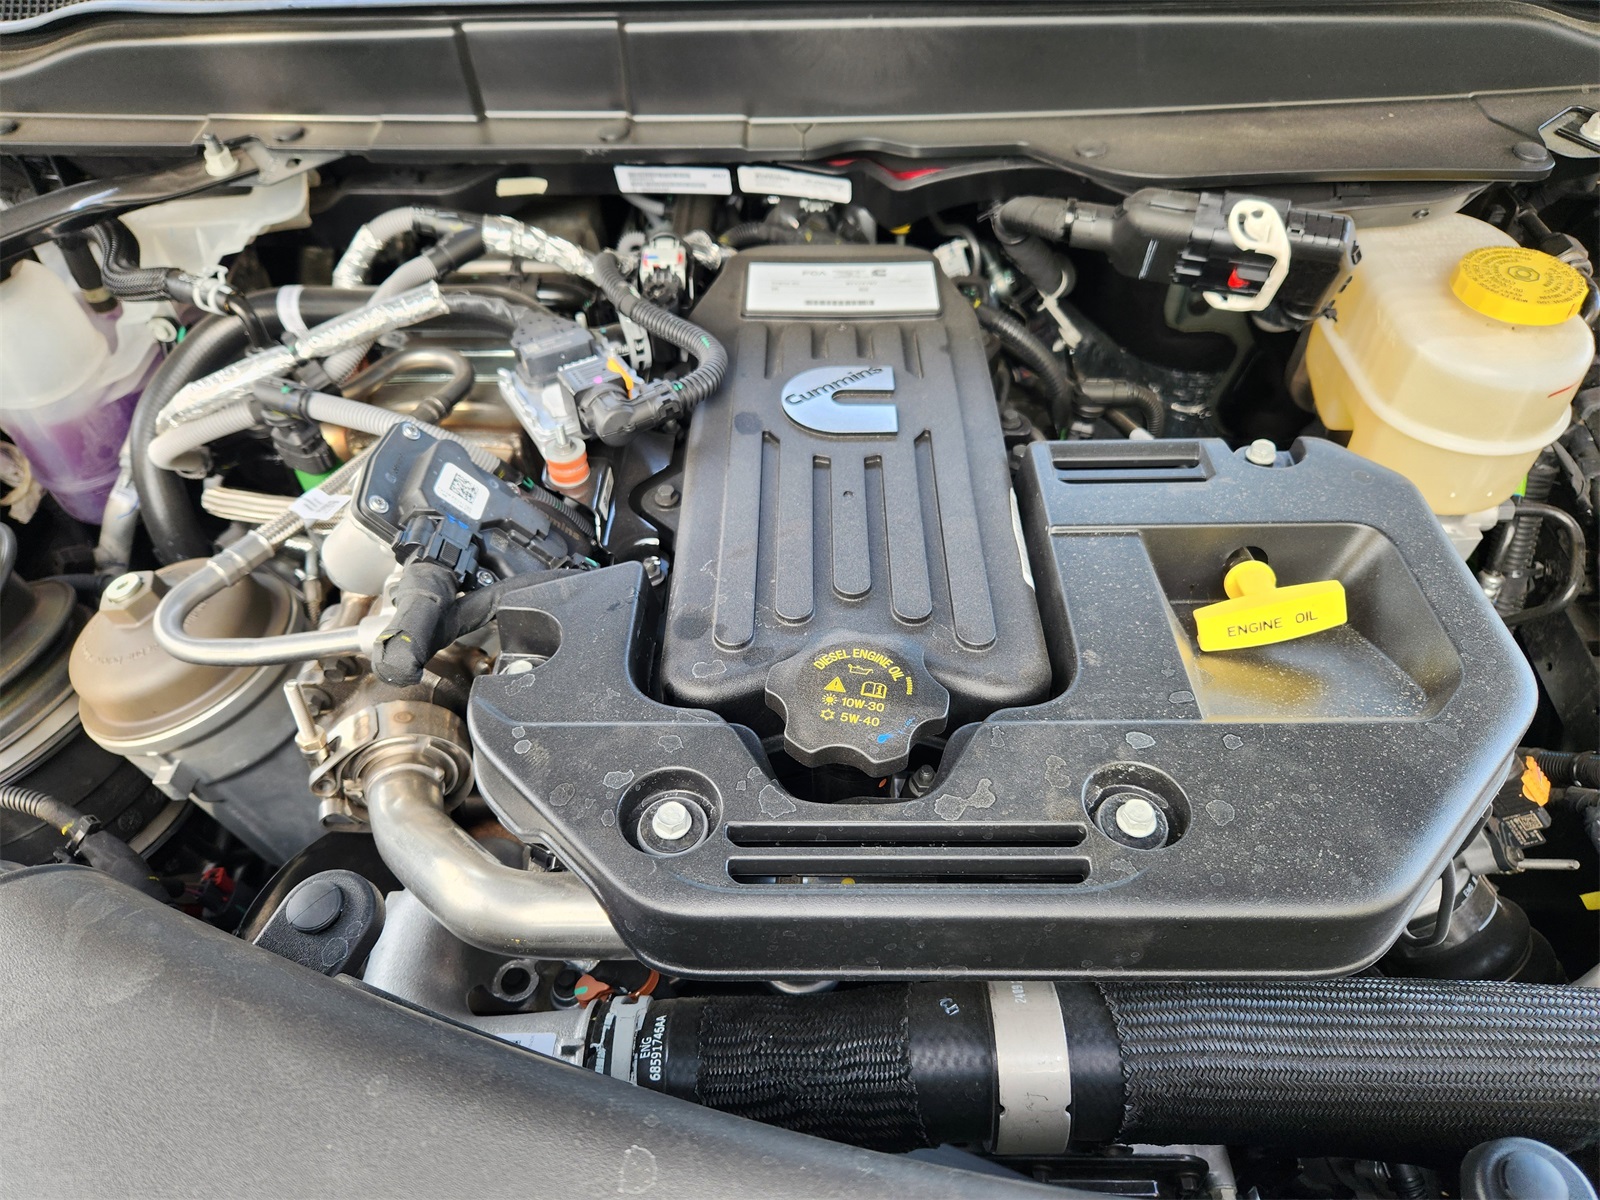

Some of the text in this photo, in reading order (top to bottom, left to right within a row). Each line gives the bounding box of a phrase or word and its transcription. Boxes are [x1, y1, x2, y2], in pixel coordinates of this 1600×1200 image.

[785, 366, 883, 405] Cummins
[1227, 610, 1318, 637] ENGINE OIL
[813, 648, 904, 682] DIESEL ENGINE OIL
[841, 697, 885, 713] 10W-30
[840, 712, 880, 727] 5W-40
[639, 1036, 652, 1059] ENG
